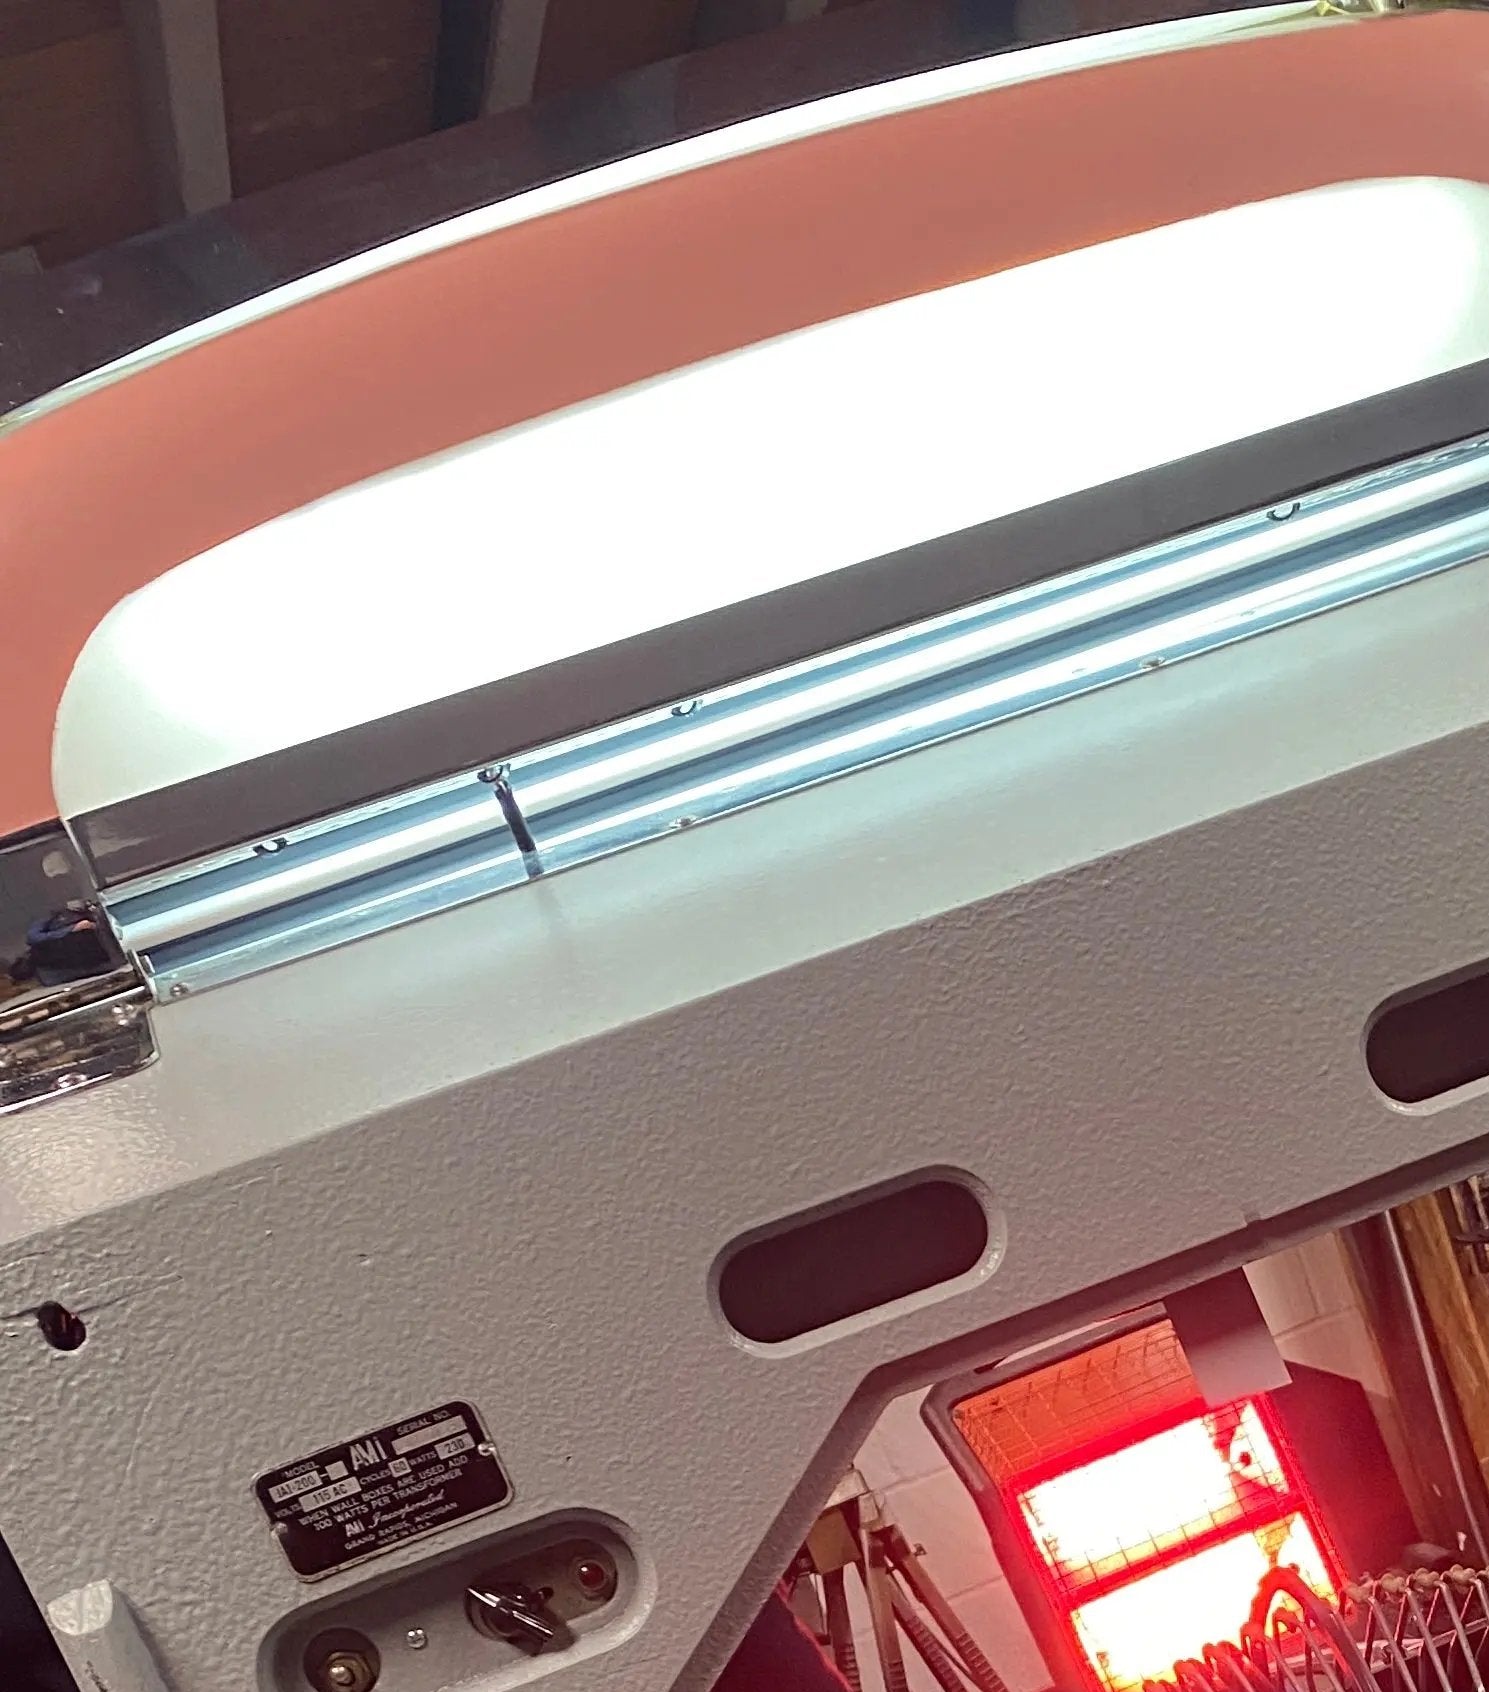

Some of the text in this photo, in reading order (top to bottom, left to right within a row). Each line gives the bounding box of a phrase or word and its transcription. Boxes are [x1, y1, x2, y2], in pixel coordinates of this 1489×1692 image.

[396, 1416, 432, 1435] SERIAL
[284, 1461, 320, 1478] MODEL
[360, 1468, 391, 1486] CYCLES
[409, 1450, 437, 1466] WATTS
[298, 1455, 468, 1526] WHEN WALL BOXES ARE USED ADD
[333, 1504, 369, 1523] WATTS
[371, 1495, 391, 1510] PER
[394, 1468, 463, 1500] TRANSFORMER
